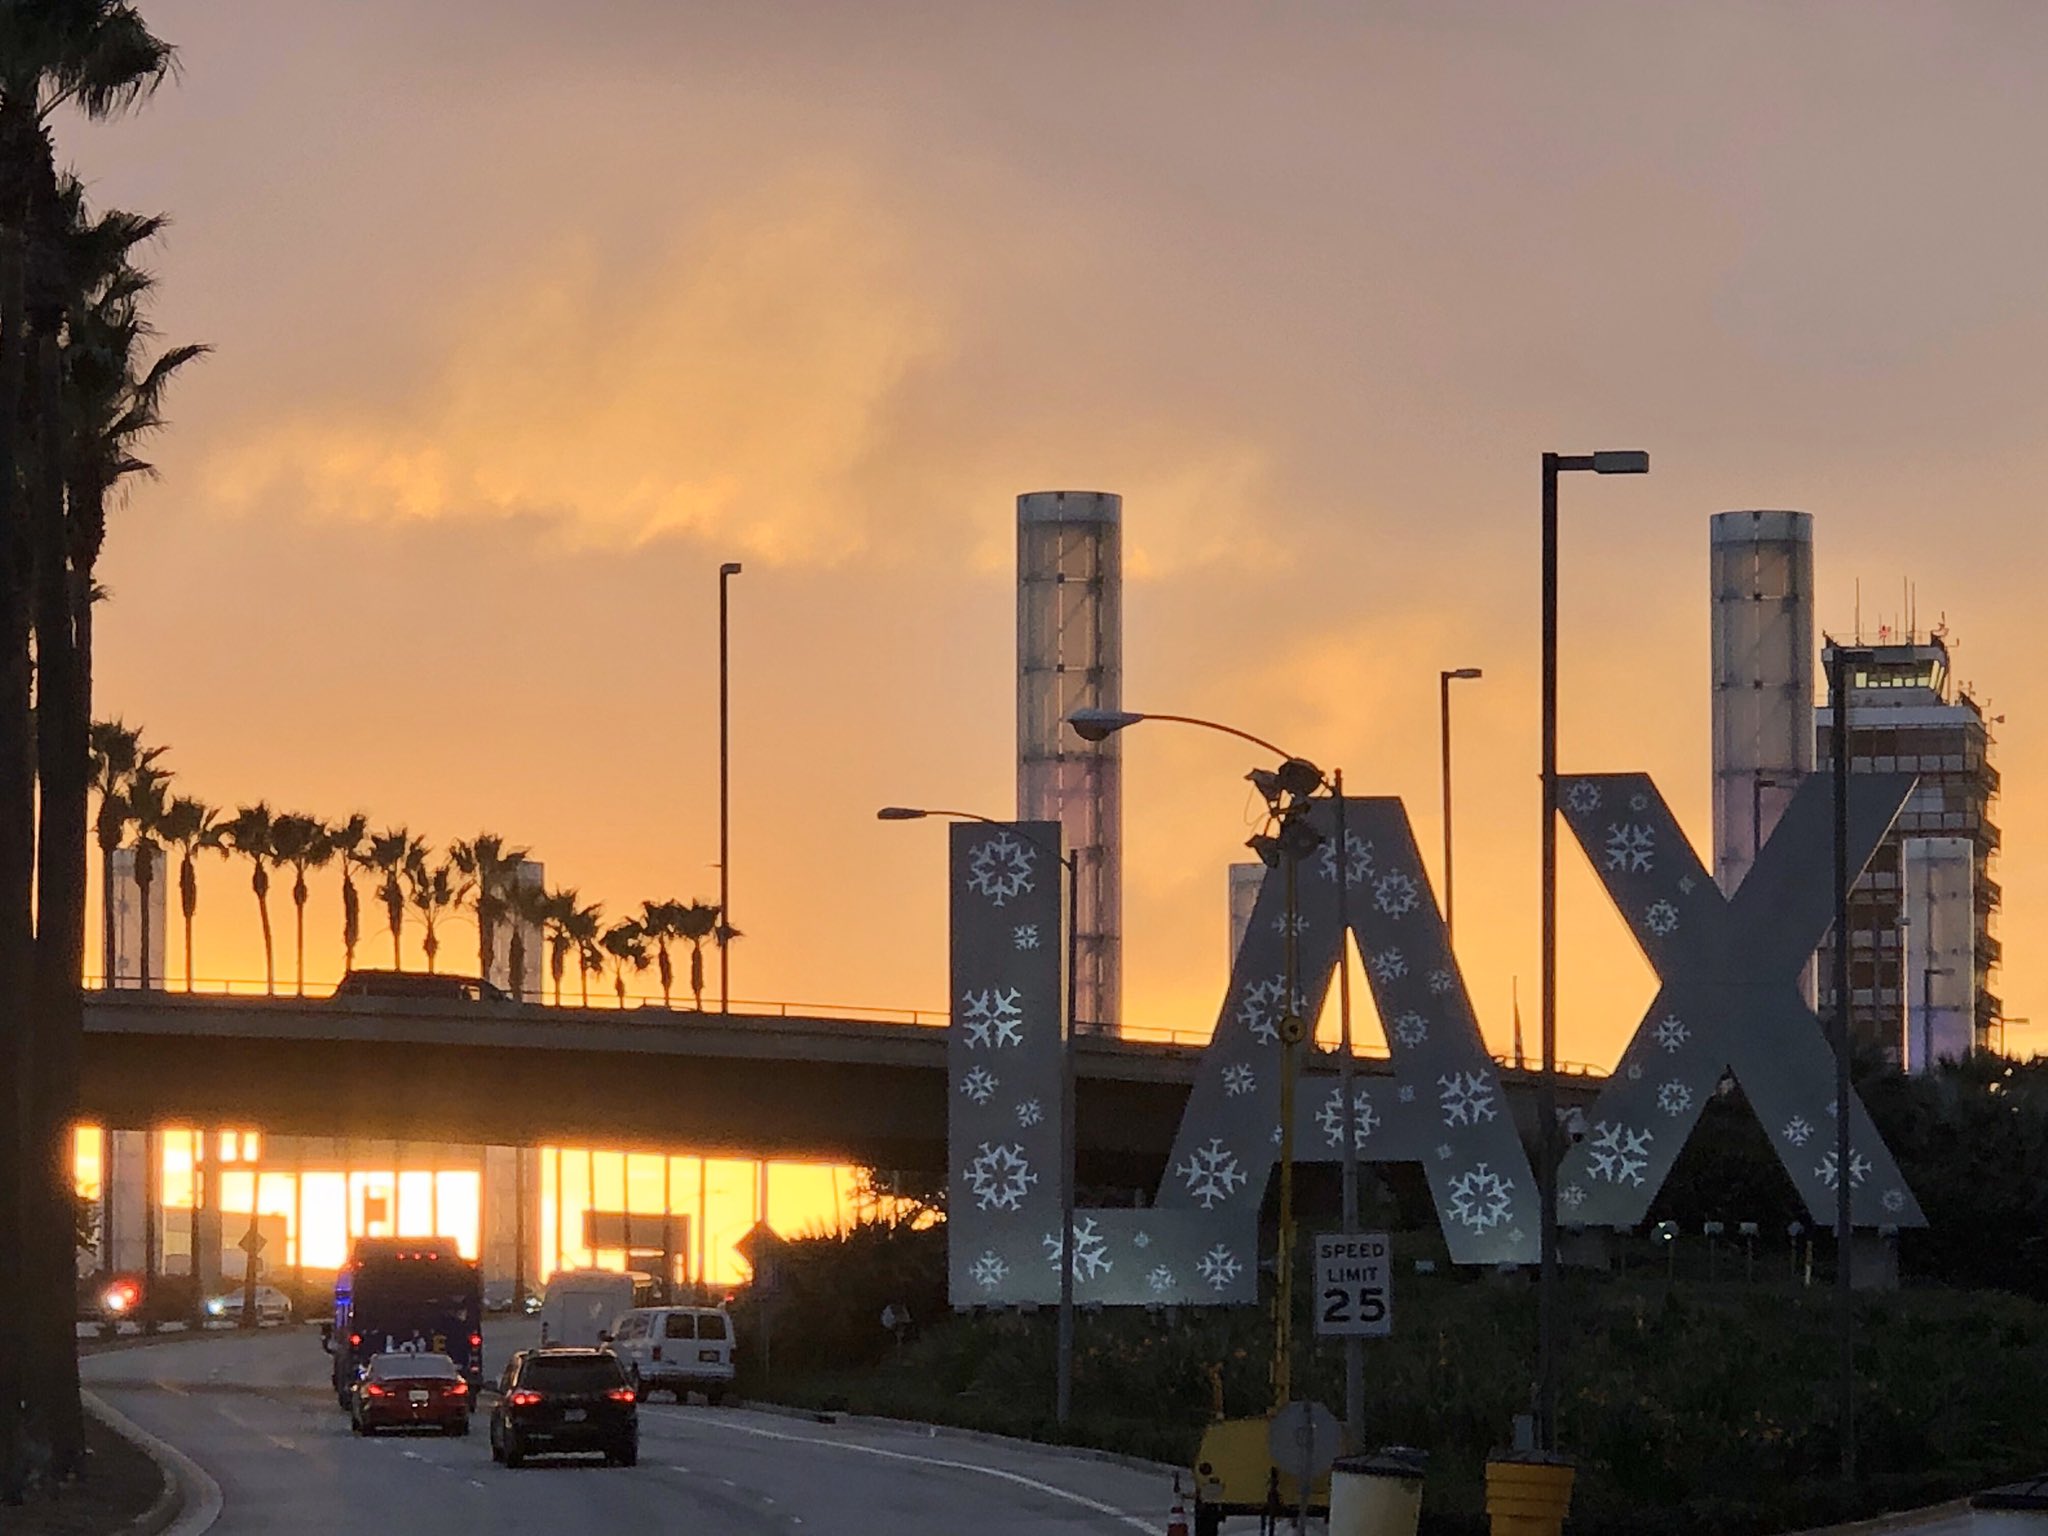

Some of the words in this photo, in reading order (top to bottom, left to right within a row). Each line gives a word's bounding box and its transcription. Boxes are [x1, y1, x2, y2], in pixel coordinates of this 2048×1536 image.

[949, 772, 1929, 1306] LAX
[1321, 1243, 1385, 1259] SPEED
[1327, 1266, 1378, 1282] LIMIT
[1323, 1287, 1386, 1322] 25
